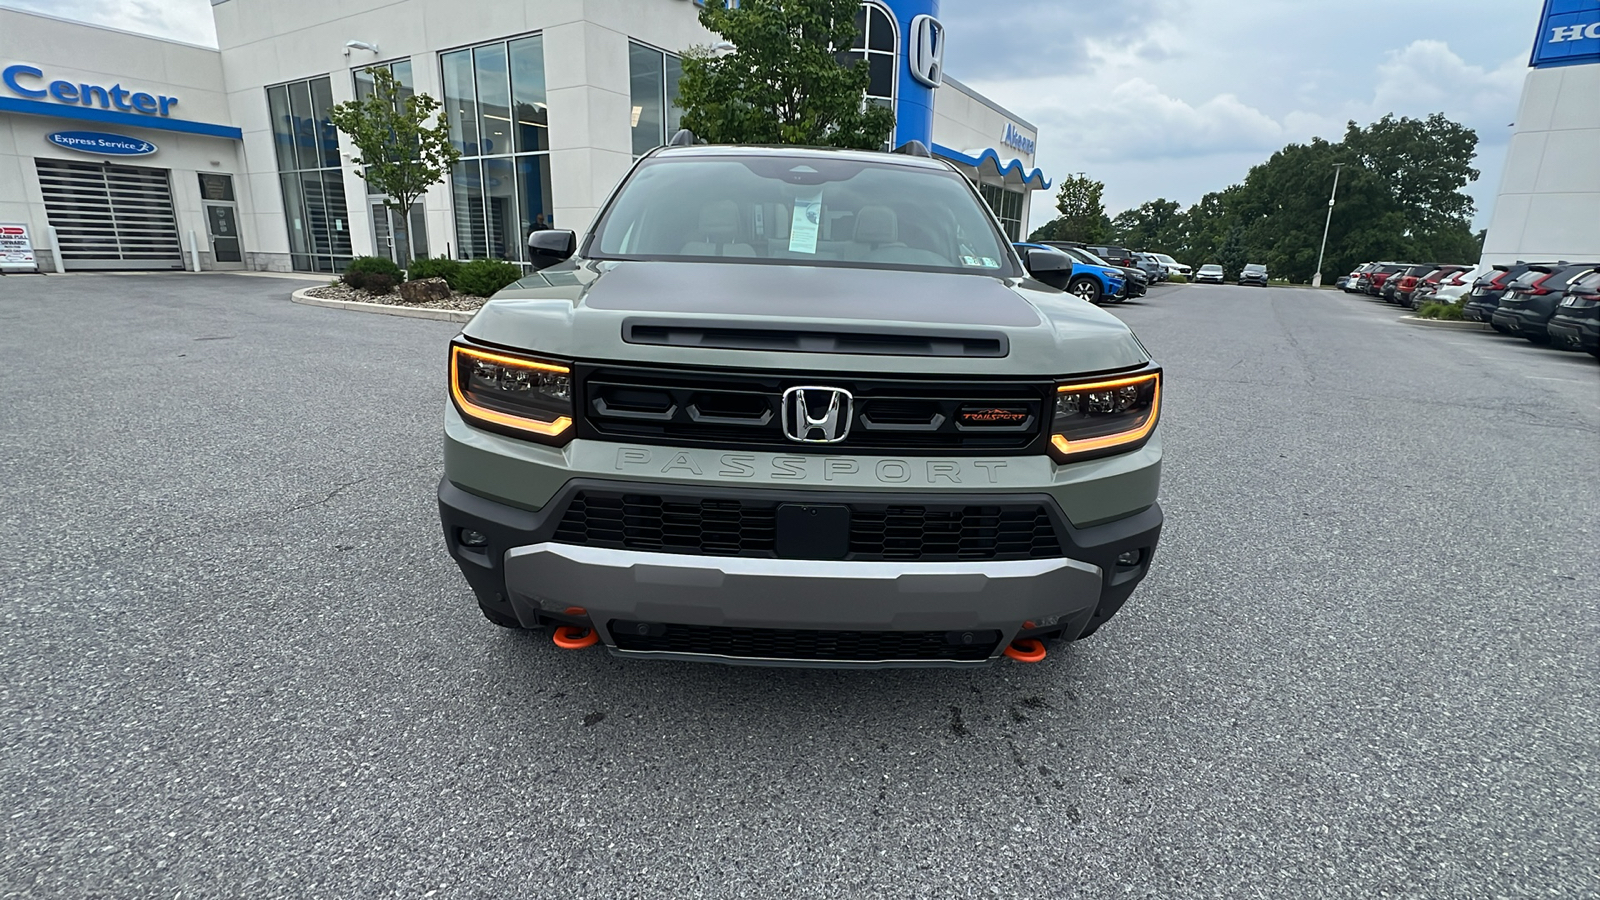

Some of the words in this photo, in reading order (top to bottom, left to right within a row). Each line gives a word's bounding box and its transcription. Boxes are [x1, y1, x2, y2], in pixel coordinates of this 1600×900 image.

[2, 64, 178, 117] Center
[54, 134, 96, 146] Express
[98, 139, 136, 150] Service
[962, 413, 1026, 421] TRAILSPORT
[615, 447, 1008, 484] PASSPORT
